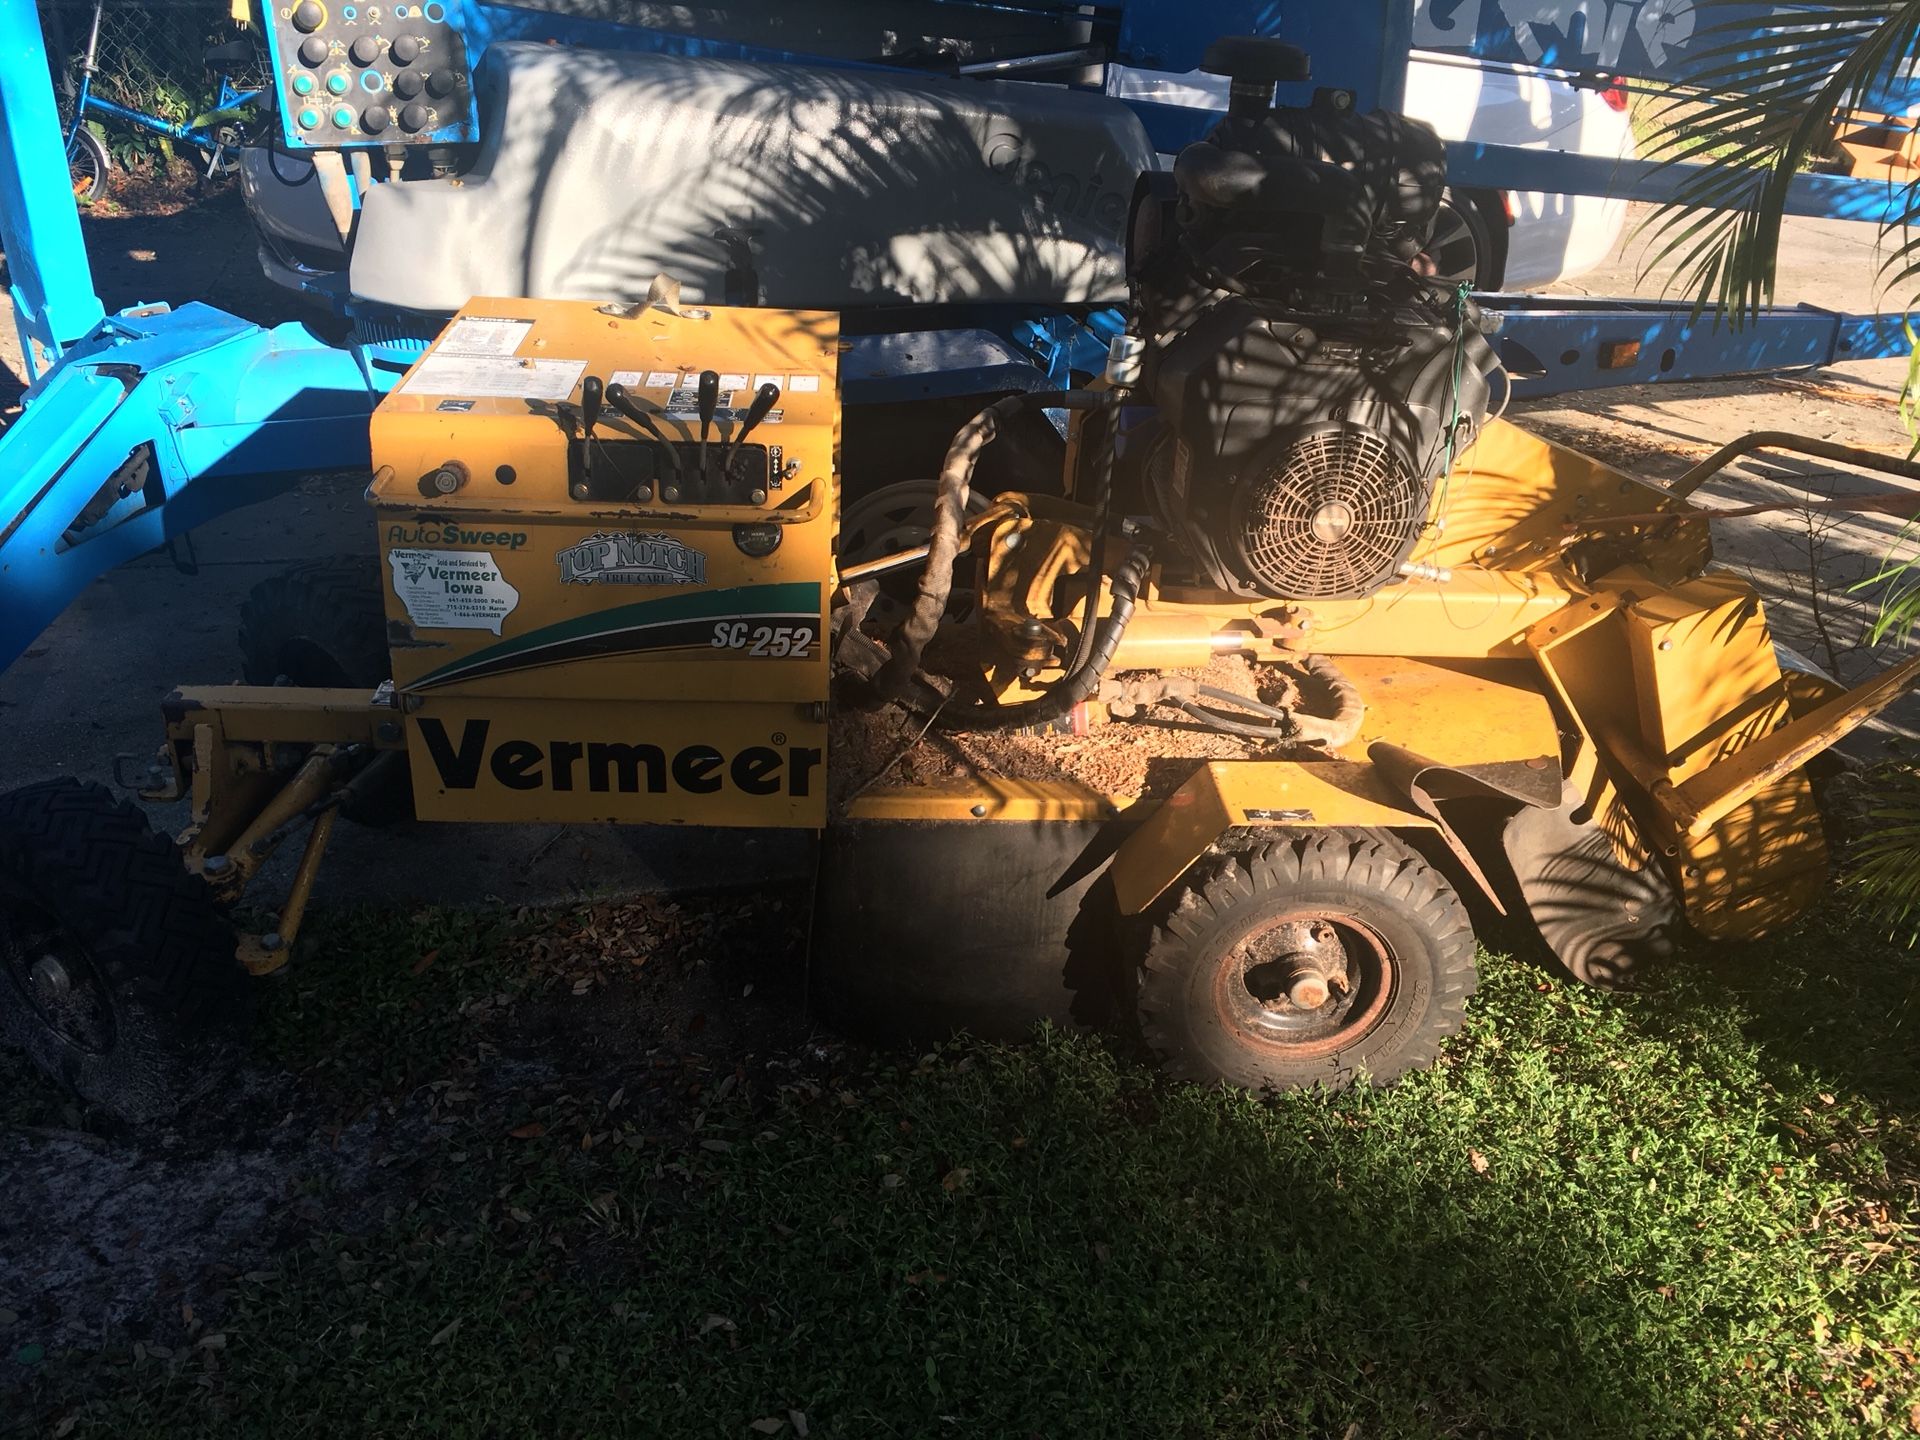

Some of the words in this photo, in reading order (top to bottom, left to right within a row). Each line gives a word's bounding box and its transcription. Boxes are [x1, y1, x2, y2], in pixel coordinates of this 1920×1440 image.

[437, 559, 448, 567] Sold
[449, 559, 458, 567] and
[557, 542, 611, 583] TOP
[612, 538, 707, 585] NOTCH
[428, 566, 498, 582] Vermeer
[605, 573, 633, 583] TREE
[637, 573, 666, 583] CARE
[444, 580, 483, 595] Iowa
[711, 622, 749, 649] SC
[748, 626, 813, 657] 252
[415, 717, 822, 797] Vermeer
